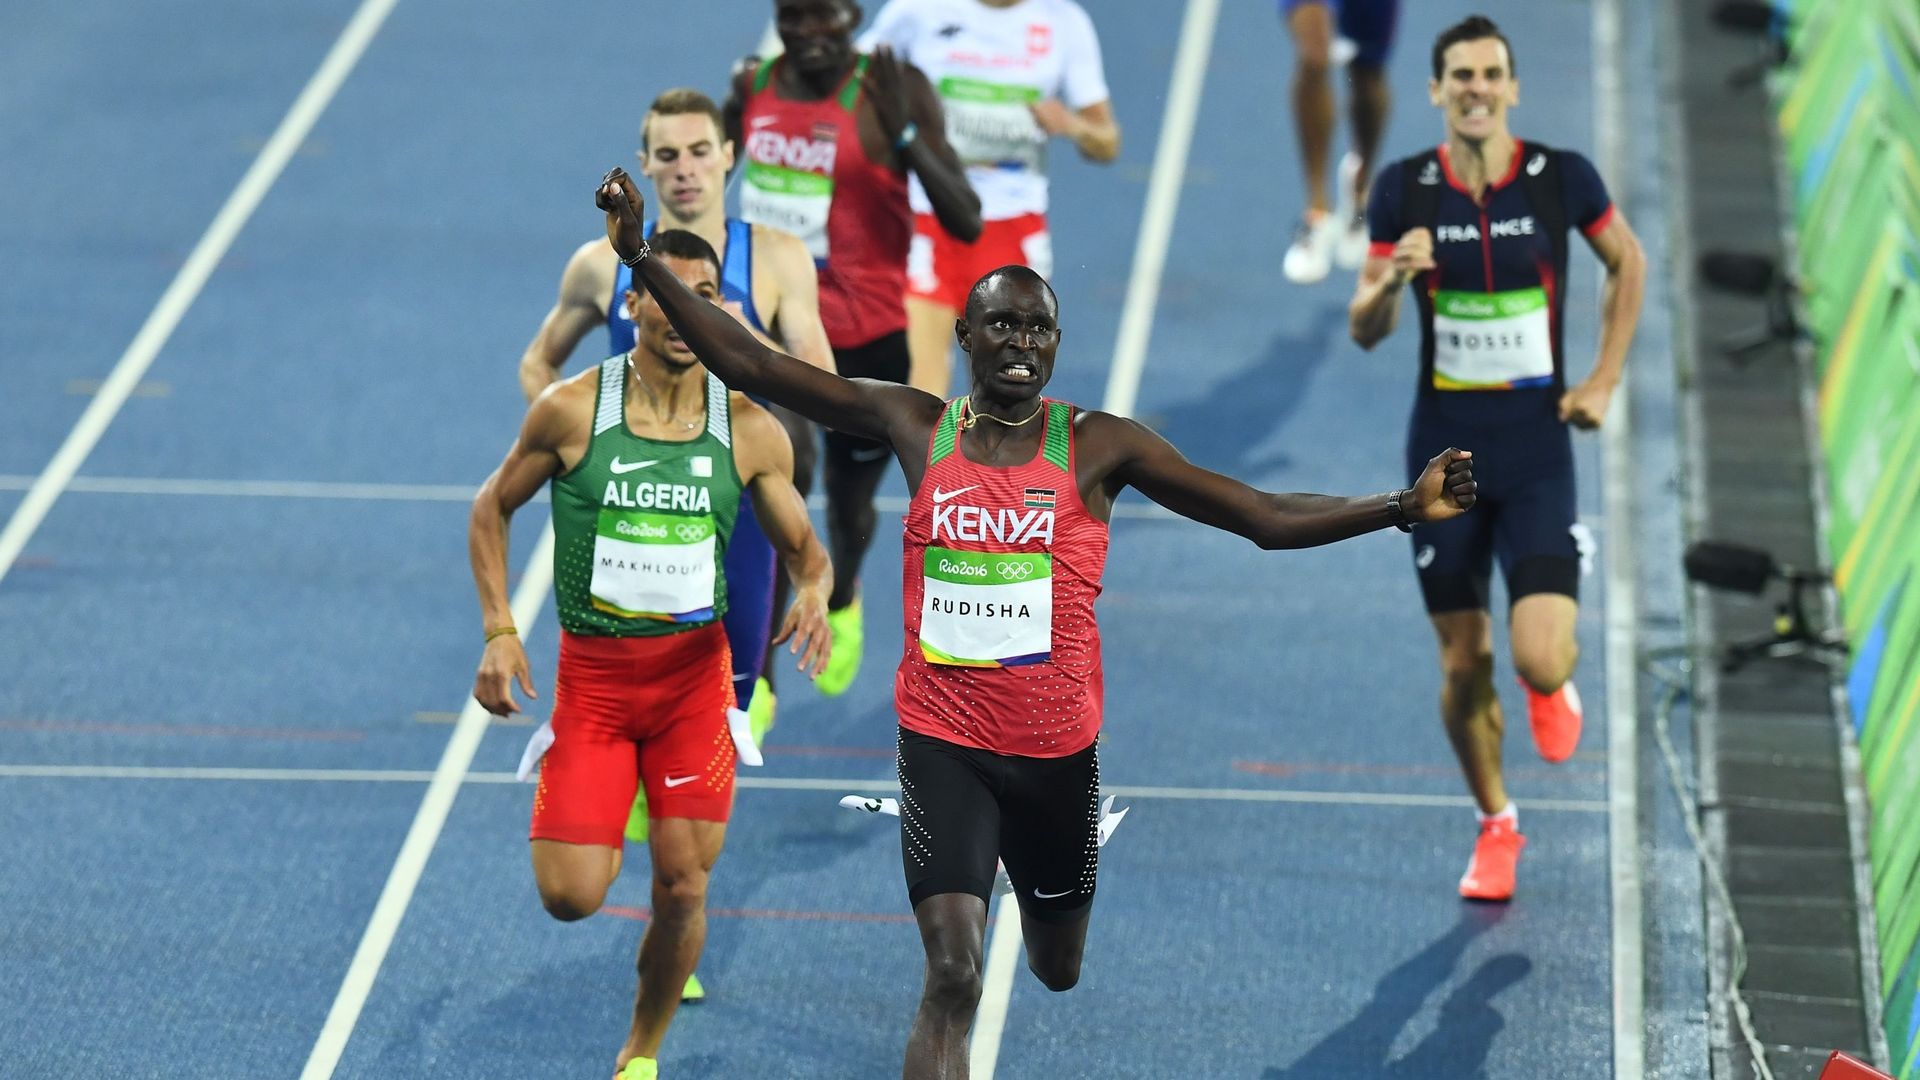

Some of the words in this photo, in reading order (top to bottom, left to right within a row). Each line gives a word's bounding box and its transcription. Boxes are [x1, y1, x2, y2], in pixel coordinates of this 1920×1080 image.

[1436, 215, 1536, 242] FRANCE
[602, 480, 711, 513] ALGERIA
[931, 505, 1055, 545] KENYA
[938, 558, 988, 577] Rio2016
[931, 597, 1031, 619] RUDISHA
